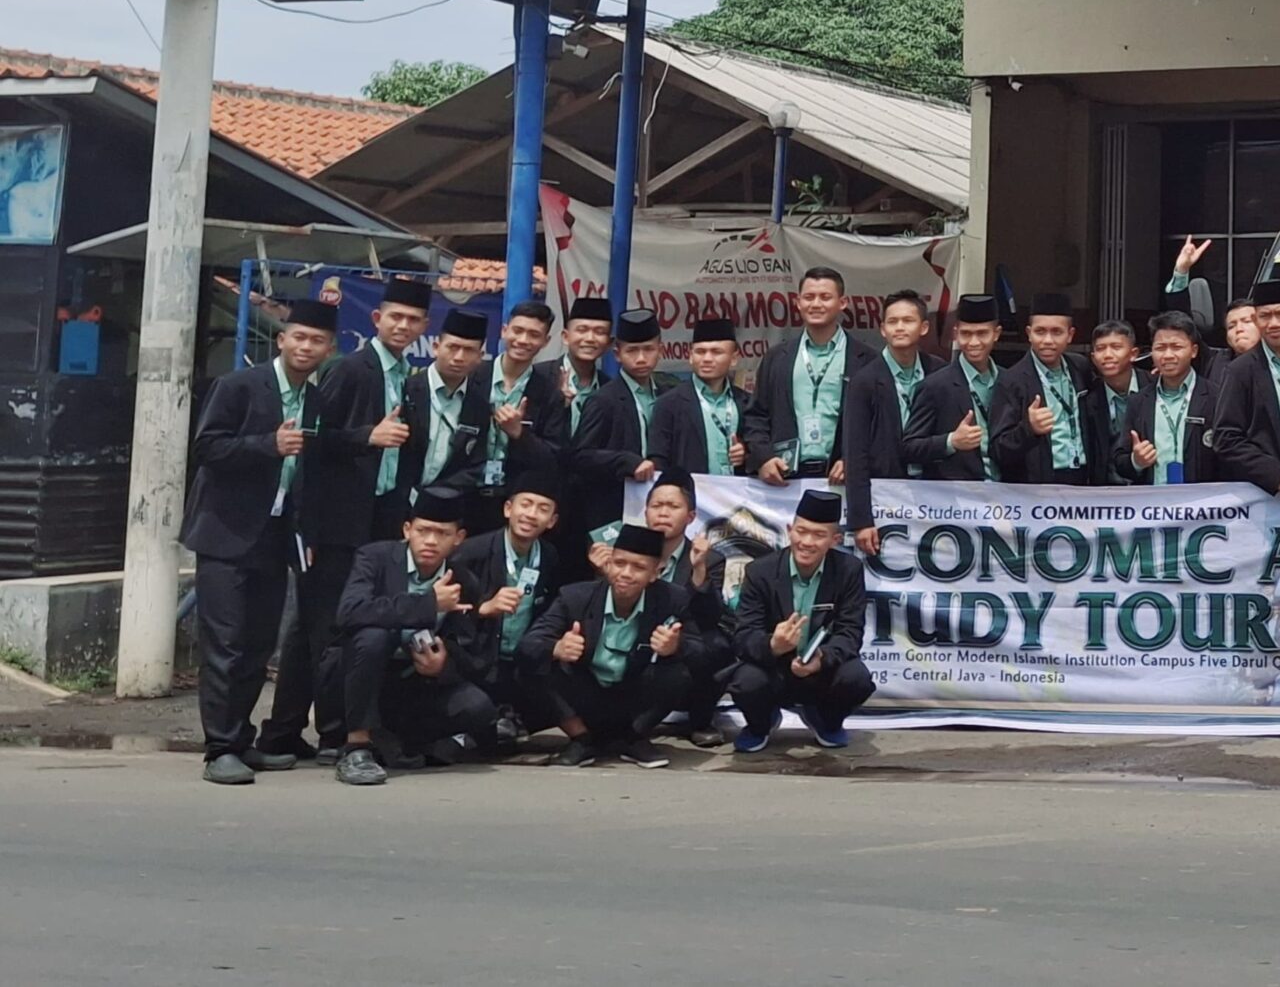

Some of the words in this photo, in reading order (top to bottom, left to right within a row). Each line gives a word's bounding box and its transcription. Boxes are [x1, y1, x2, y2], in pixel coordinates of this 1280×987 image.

[700, 258, 733, 274] AGUS
[737, 258, 760, 274] LIO
[763, 258, 792, 274] BAN
[684, 292, 741, 330] BAN
[918, 504, 978, 520] Student
[983, 505, 1022, 520] 2025
[1031, 505, 1136, 521] COMMITTED
[1142, 505, 1250, 521] GENERATION
[865, 524, 1236, 584] CONOMIC
[864, 590, 1057, 651] TUDY
[861, 649, 900, 662] salam
[905, 649, 952, 663] Gontor
[957, 650, 1009, 664] Modern
[1014, 652, 1060, 666] Islamic
[1065, 653, 1136, 667] Institution
[1140, 654, 1195, 670] Campus
[1200, 654, 1227, 668] Five
[1232, 655, 1268, 669] Darul
[902, 667, 952, 682] Central
[957, 670, 986, 684] Java
[1000, 670, 1066, 684] Indonesia
